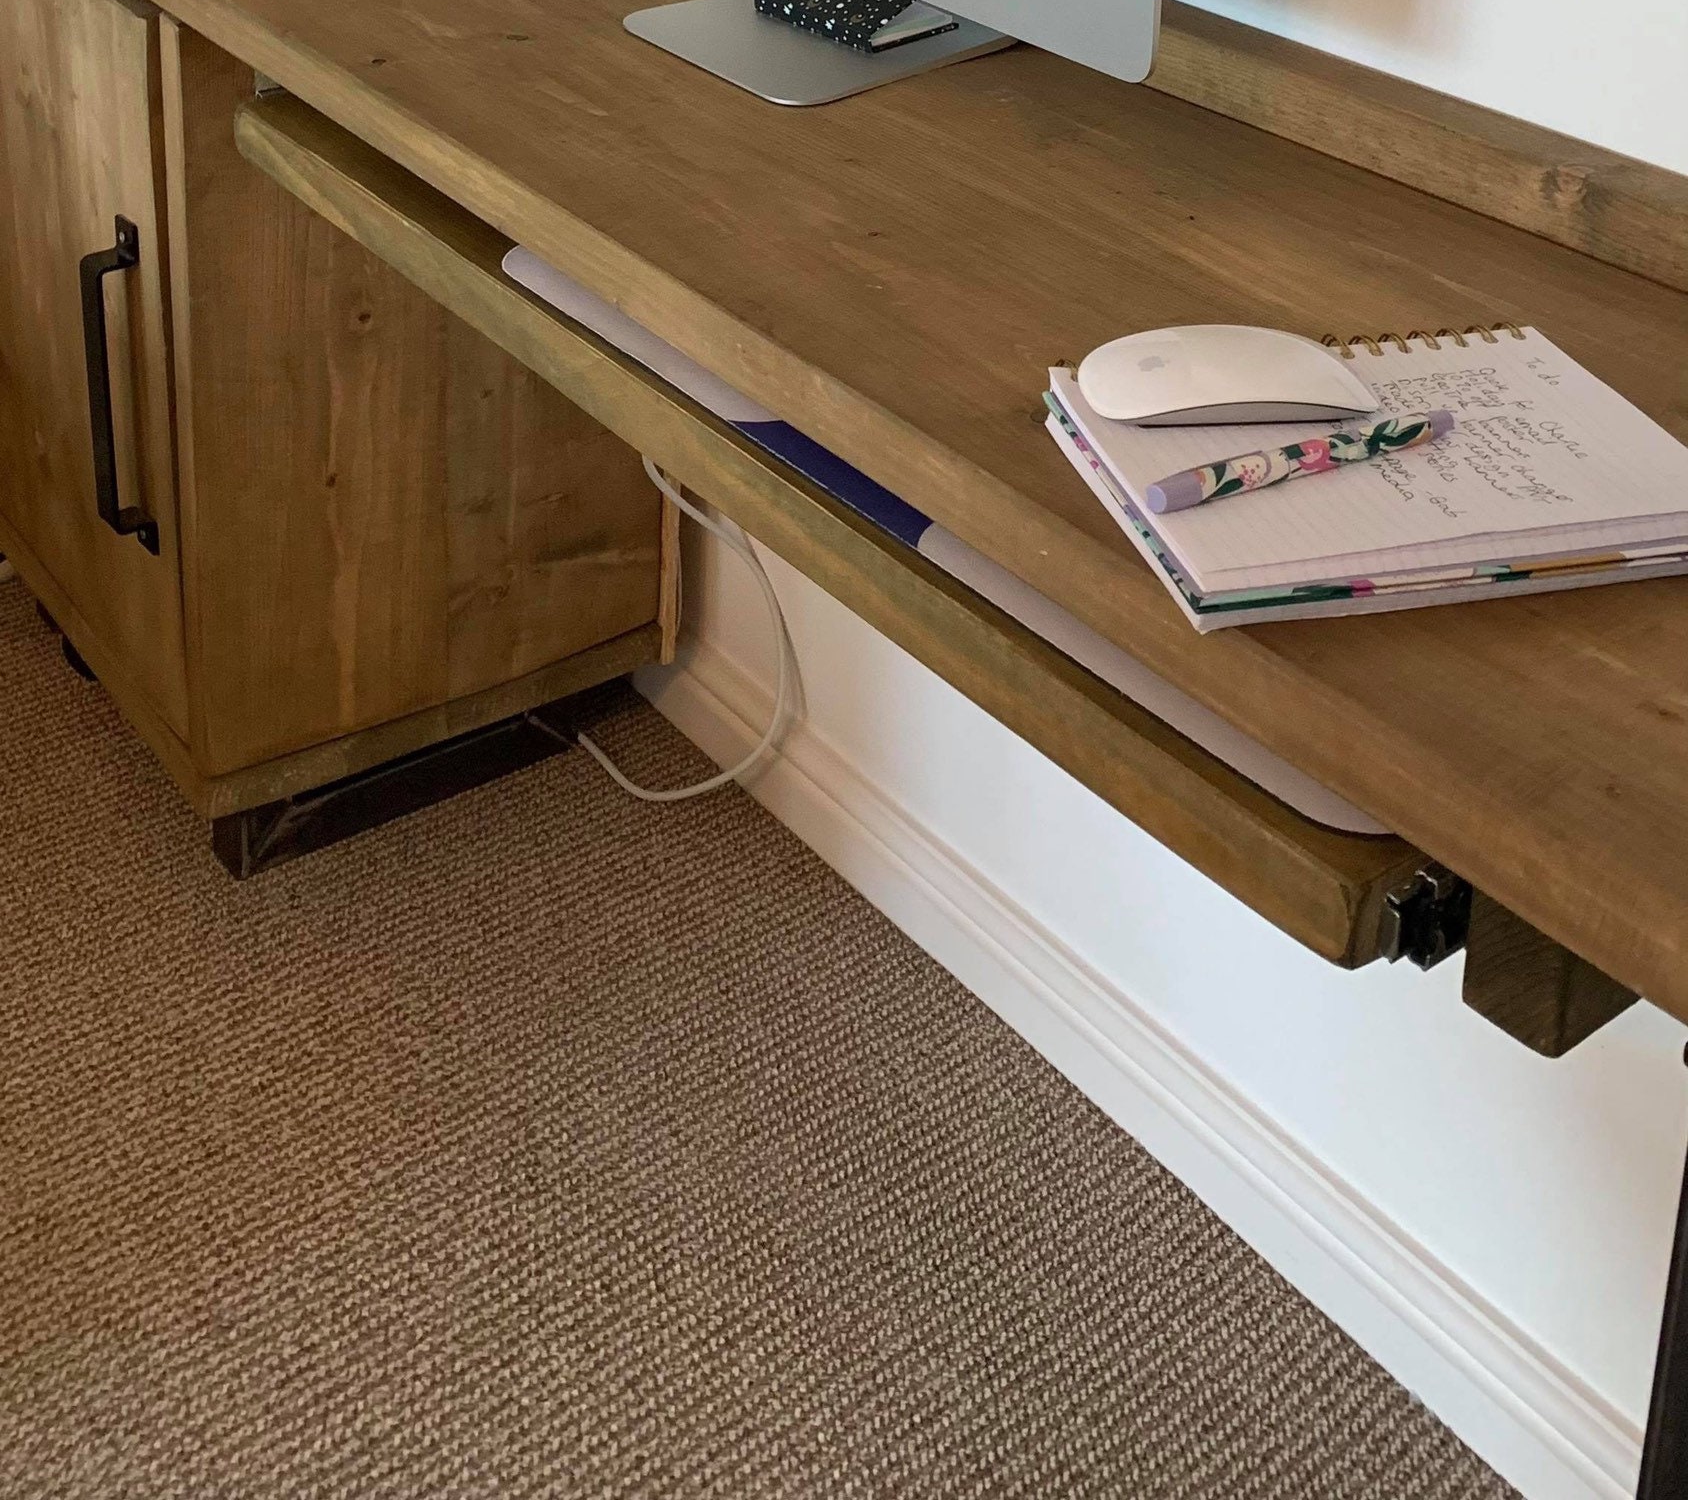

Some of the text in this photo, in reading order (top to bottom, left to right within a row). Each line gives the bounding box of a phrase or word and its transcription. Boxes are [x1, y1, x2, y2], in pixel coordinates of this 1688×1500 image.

[1526, 357, 1561, 386] To do
[1515, 417, 1558, 445] email
[1465, 443, 1509, 478] design
